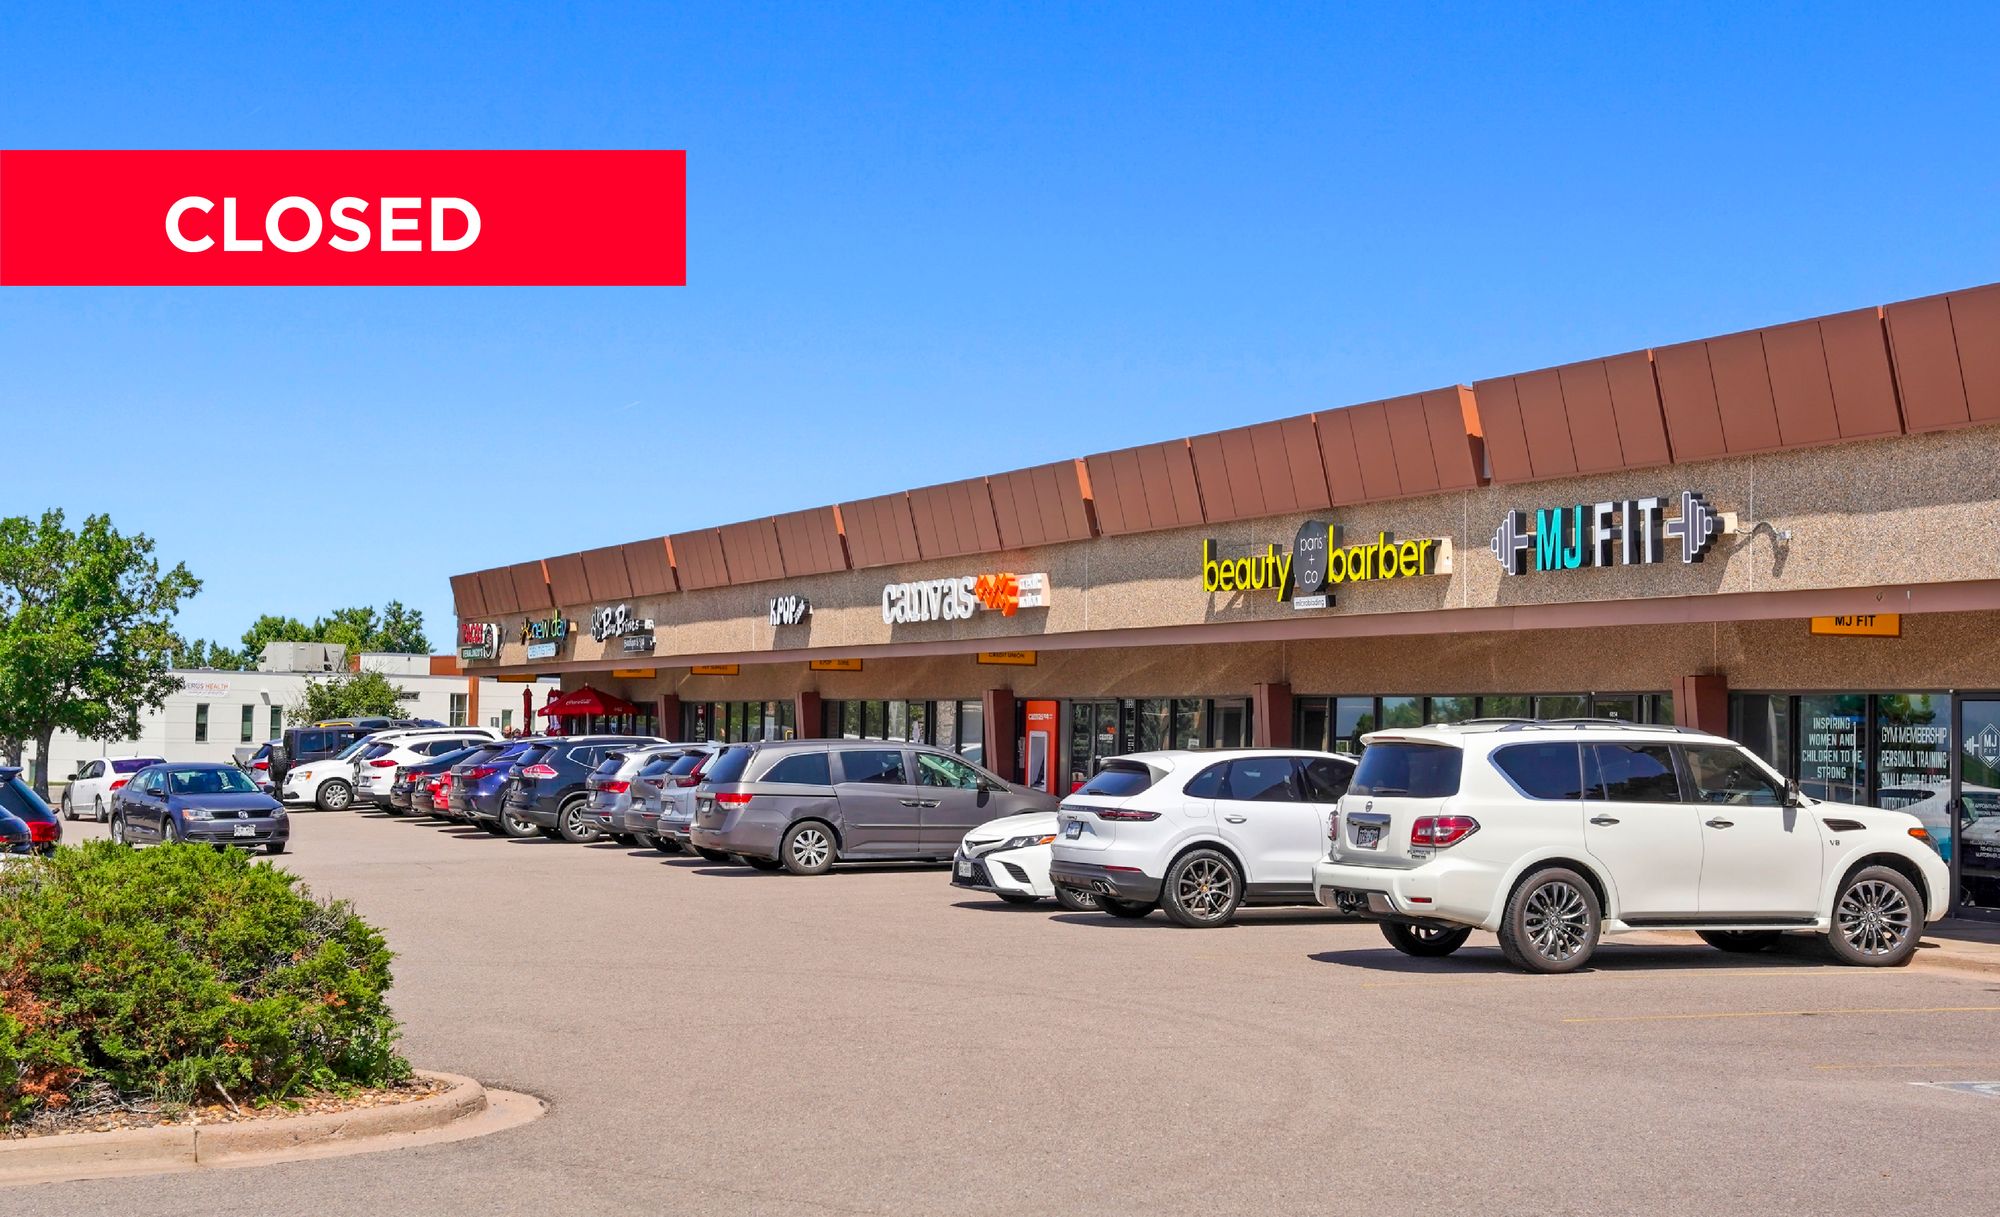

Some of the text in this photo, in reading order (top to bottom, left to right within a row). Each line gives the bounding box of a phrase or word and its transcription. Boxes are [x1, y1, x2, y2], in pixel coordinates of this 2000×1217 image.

[1535, 497, 1660, 571] MJ FIT
[1299, 534, 1323, 555] paris
[1203, 524, 1434, 602] beauty barber
[1304, 570, 1318, 584] co
[882, 575, 975, 625] canvas
[1294, 597, 1325, 609] microblading
[770, 595, 796, 626] KPOP
[531, 608, 567, 640] new day
[1835, 615, 1876, 627] MJ FIT
[1813, 717, 1851, 730] INSPIRING
[1808, 733, 1856, 747] WOMEN AND
[1881, 726, 1947, 745] GYM MEMBERSHIP
[1984, 734, 1998, 748] MJ
[1802, 750, 1839, 763] CHILDREN
[1840, 750, 1851, 763] TO
[1881, 750, 1948, 769] PERSONAL TRAINING
[1817, 766, 1847, 779] STRONG
[1829, 839, 1840, 847] V8
